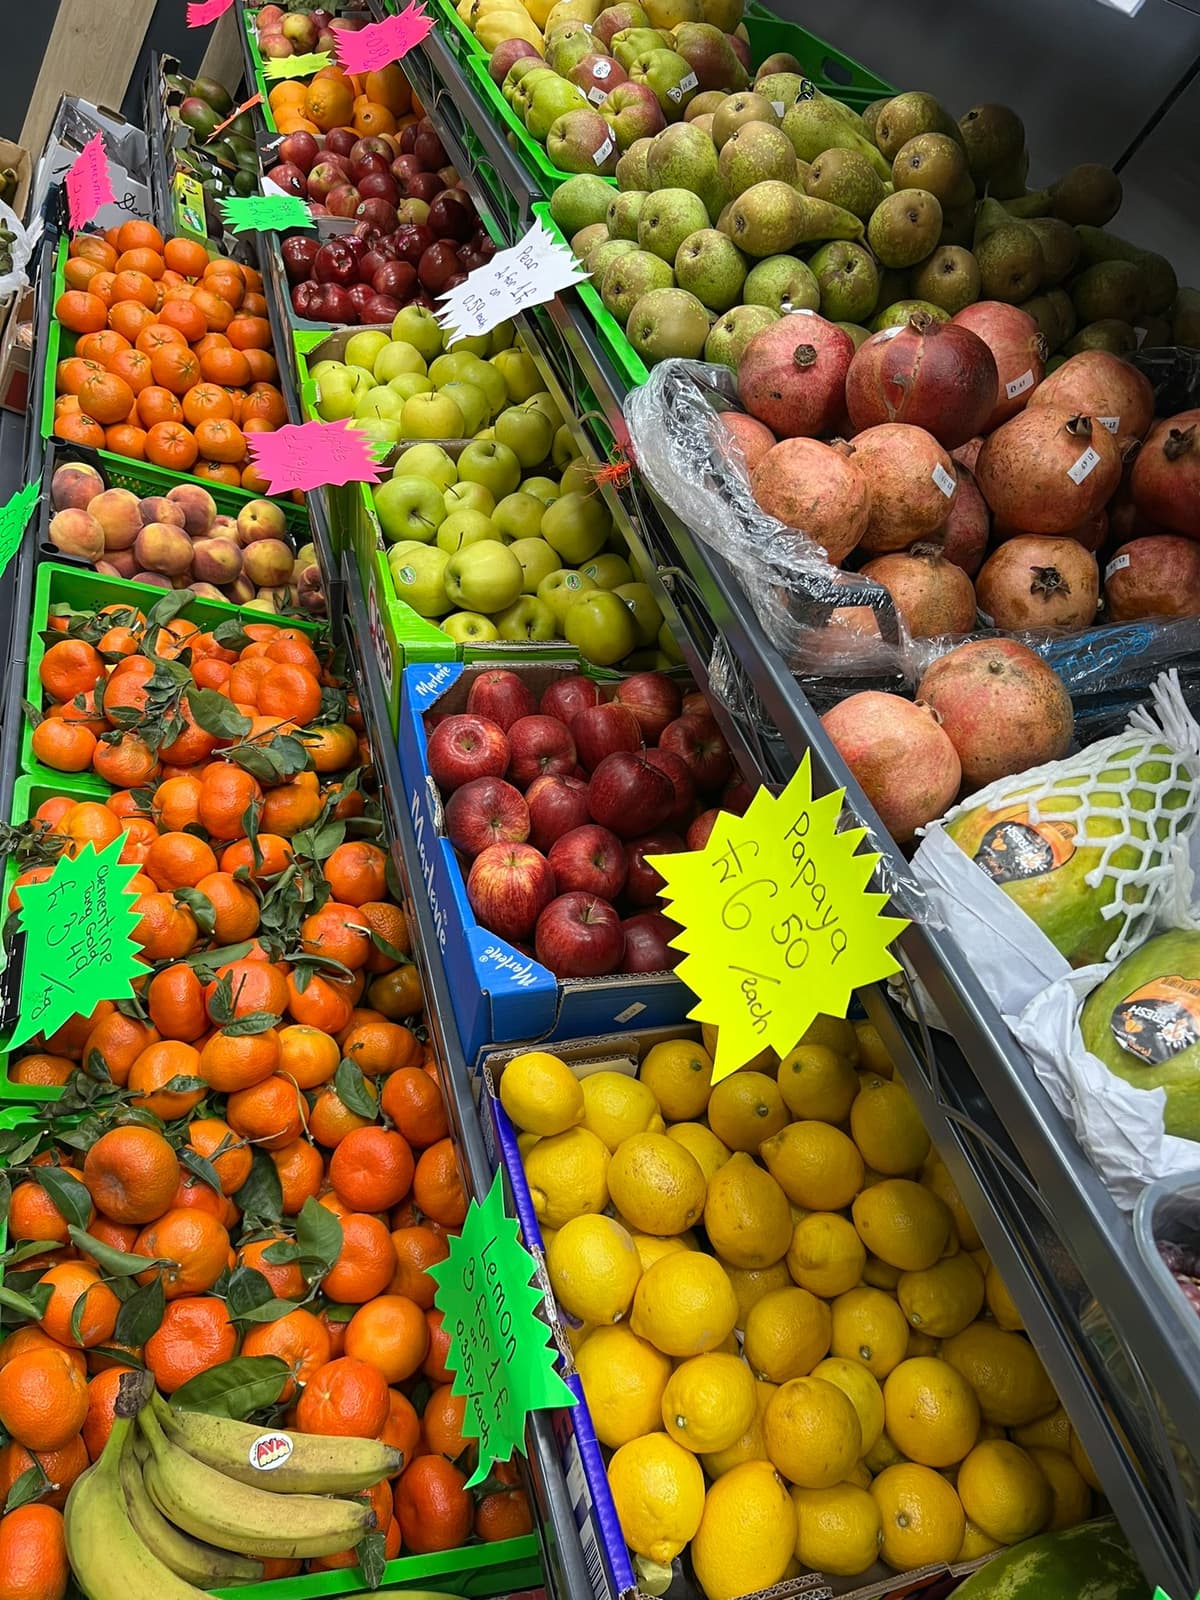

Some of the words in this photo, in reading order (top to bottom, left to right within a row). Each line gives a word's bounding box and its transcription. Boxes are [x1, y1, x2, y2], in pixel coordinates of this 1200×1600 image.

[515, 245, 539, 271] Pear
[96, 864, 116, 967] Clementine
[411, 788, 447, 955] Marlene
[783, 810, 848, 966] Papaya
[482, 945, 538, 987] Marlene
[462, 1256, 476, 1292] 3
[474, 1293, 490, 1353] for
[480, 1235, 518, 1364] Lemon
[256, 1438, 287, 1460] AVA
